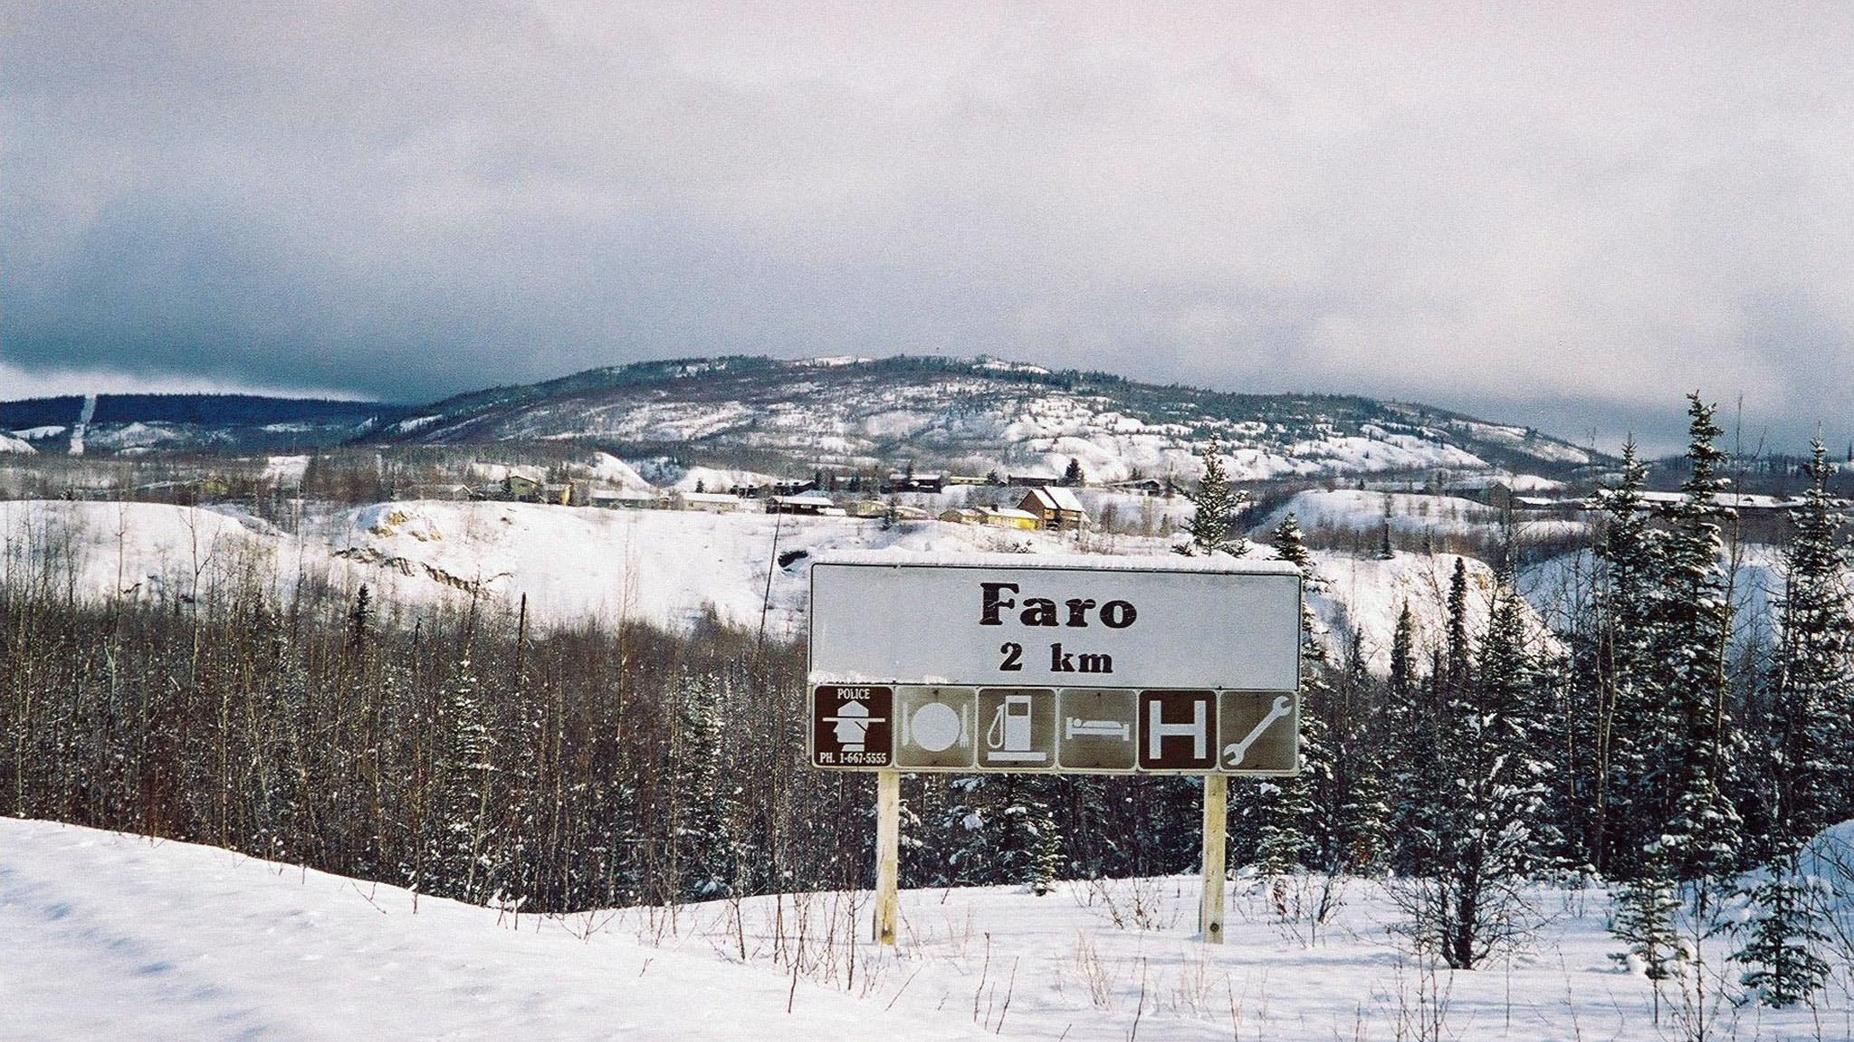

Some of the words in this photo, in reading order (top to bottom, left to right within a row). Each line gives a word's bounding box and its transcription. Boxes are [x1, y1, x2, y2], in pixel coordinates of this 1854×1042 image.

[979, 582, 1138, 629] Faro
[999, 642, 1023, 672] 2
[1050, 643, 1113, 673] km
[837, 688, 871, 700] POLICE
[1149, 700, 1206, 760] H
[819, 752, 836, 764] PH.
[839, 752, 887, 764] 1-667-5555
